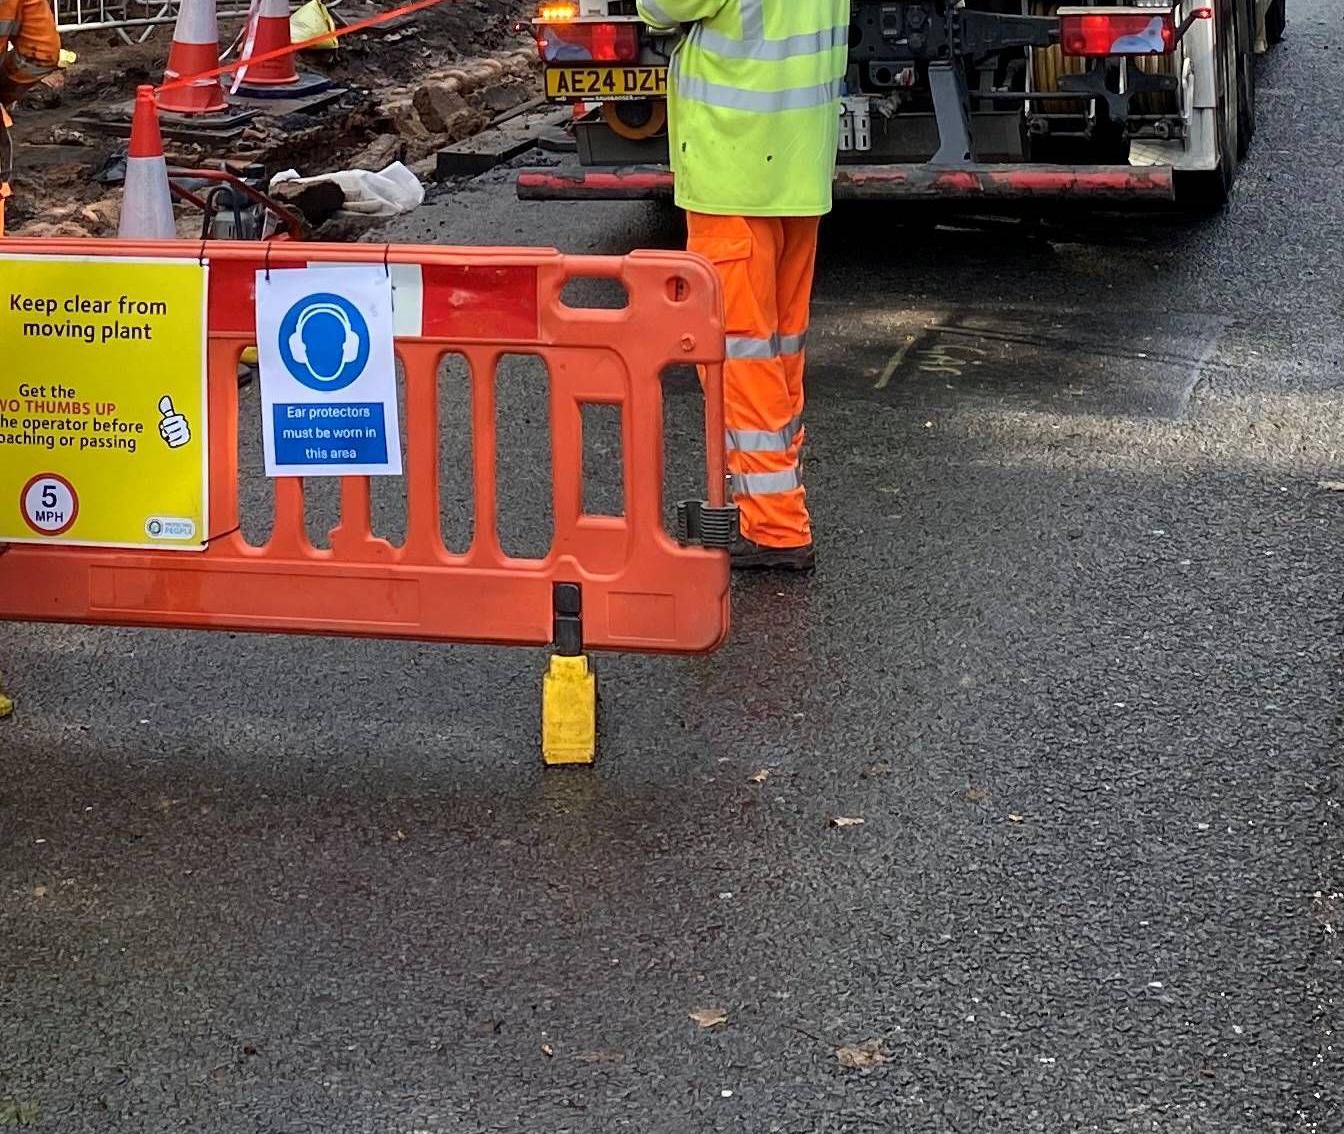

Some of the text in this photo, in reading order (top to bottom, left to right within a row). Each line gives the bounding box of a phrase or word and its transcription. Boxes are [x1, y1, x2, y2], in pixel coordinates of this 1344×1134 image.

[556, 69, 668, 93] AE24 DZH
[9, 294, 167, 316] Keep clear from
[23, 319, 153, 343] moving plant
[19, 383, 76, 399] Get the
[26, 400, 90, 415] THUMBS
[96, 402, 116, 416] UP
[287, 406, 371, 420] Ear protectors
[23, 417, 88, 434] operator
[93, 418, 144, 433] before
[283, 427, 377, 439] must be worn in
[59, 435, 75, 447] or
[80, 435, 137, 453] passing
[305, 448, 357, 460] this area
[41, 485, 57, 508] 5
[35, 511, 64, 523] MPH
